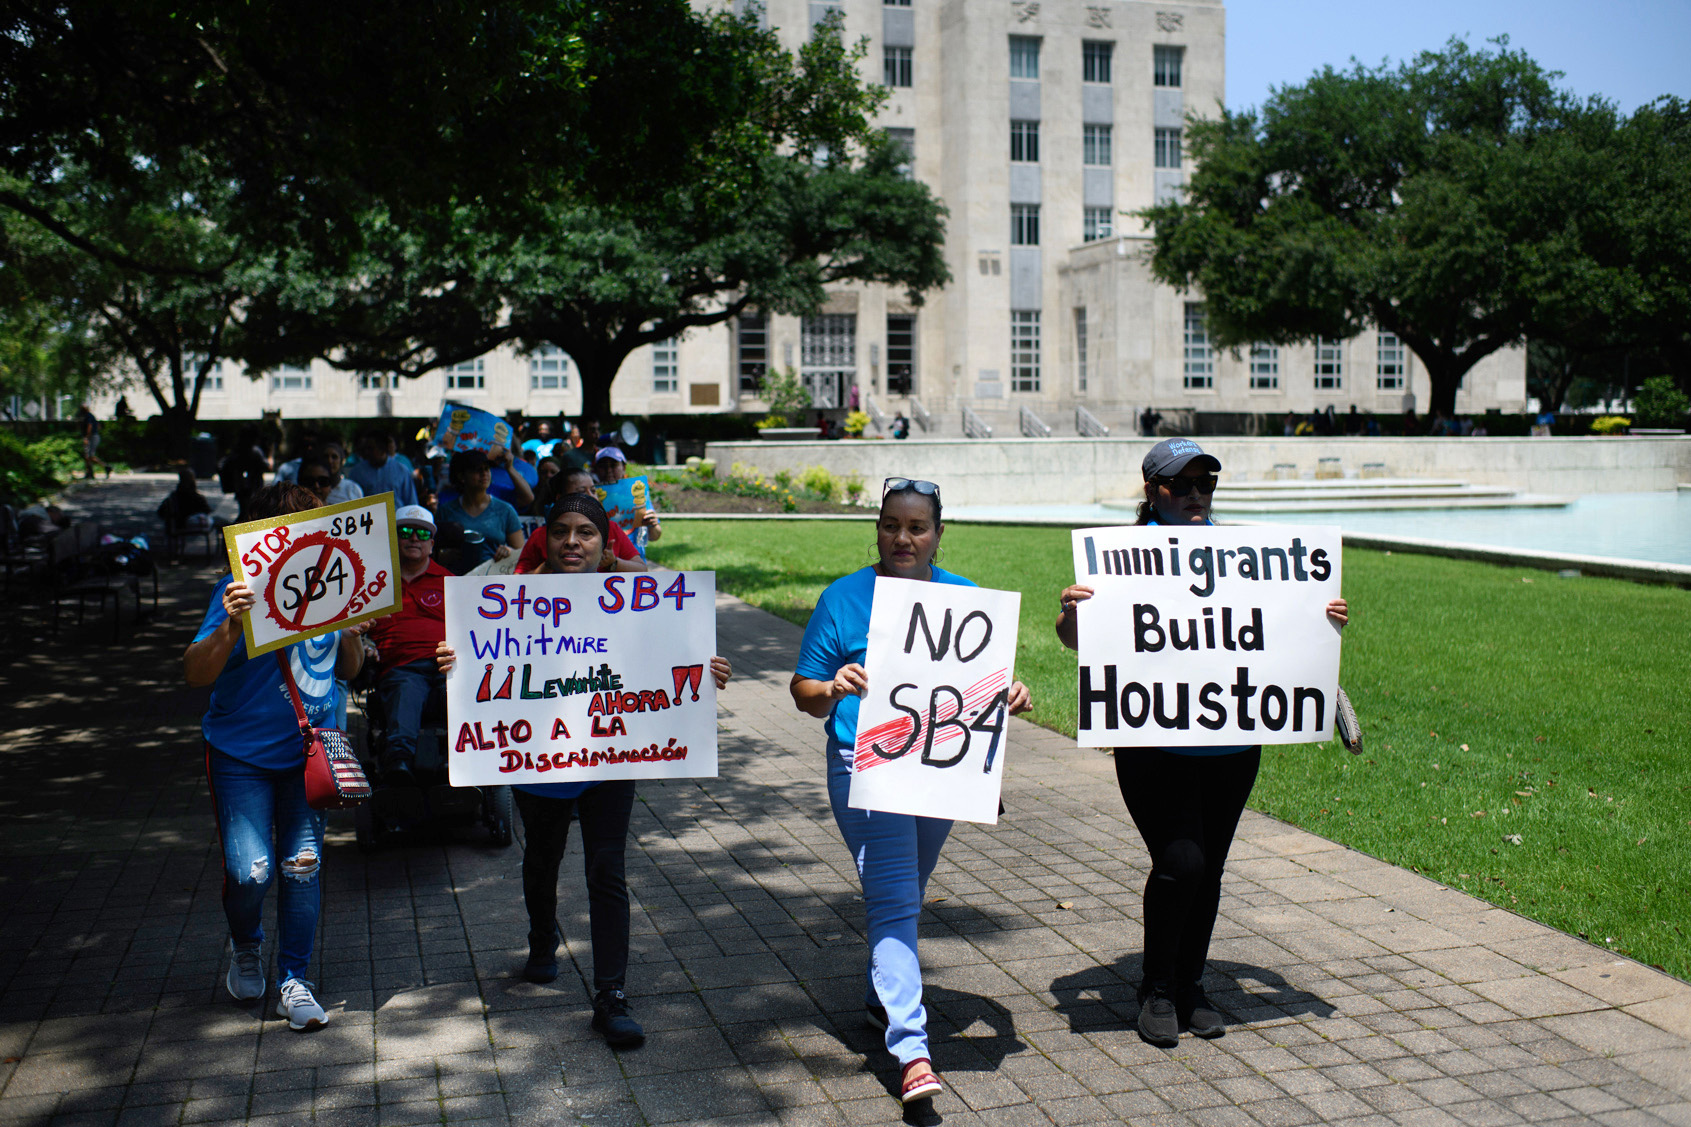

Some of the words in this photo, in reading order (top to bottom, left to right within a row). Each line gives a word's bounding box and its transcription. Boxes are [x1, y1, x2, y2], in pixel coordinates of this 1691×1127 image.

[330, 511, 373, 536] SB4
[241, 525, 292, 577] STOP
[1084, 536, 1332, 598] Immigrants
[282, 556, 348, 611] SB4
[349, 570, 388, 614] STOP
[477, 583, 572, 628] Stop
[598, 573, 696, 614] SB4
[903, 602, 993, 663] NO
[1132, 603, 1265, 653] Build
[587, 664, 704, 717] AHORA!!
[1079, 664, 1325, 732] Houston
[550, 717, 571, 740] A
[590, 715, 627, 738] LA
[871, 683, 1010, 774] SB-4
